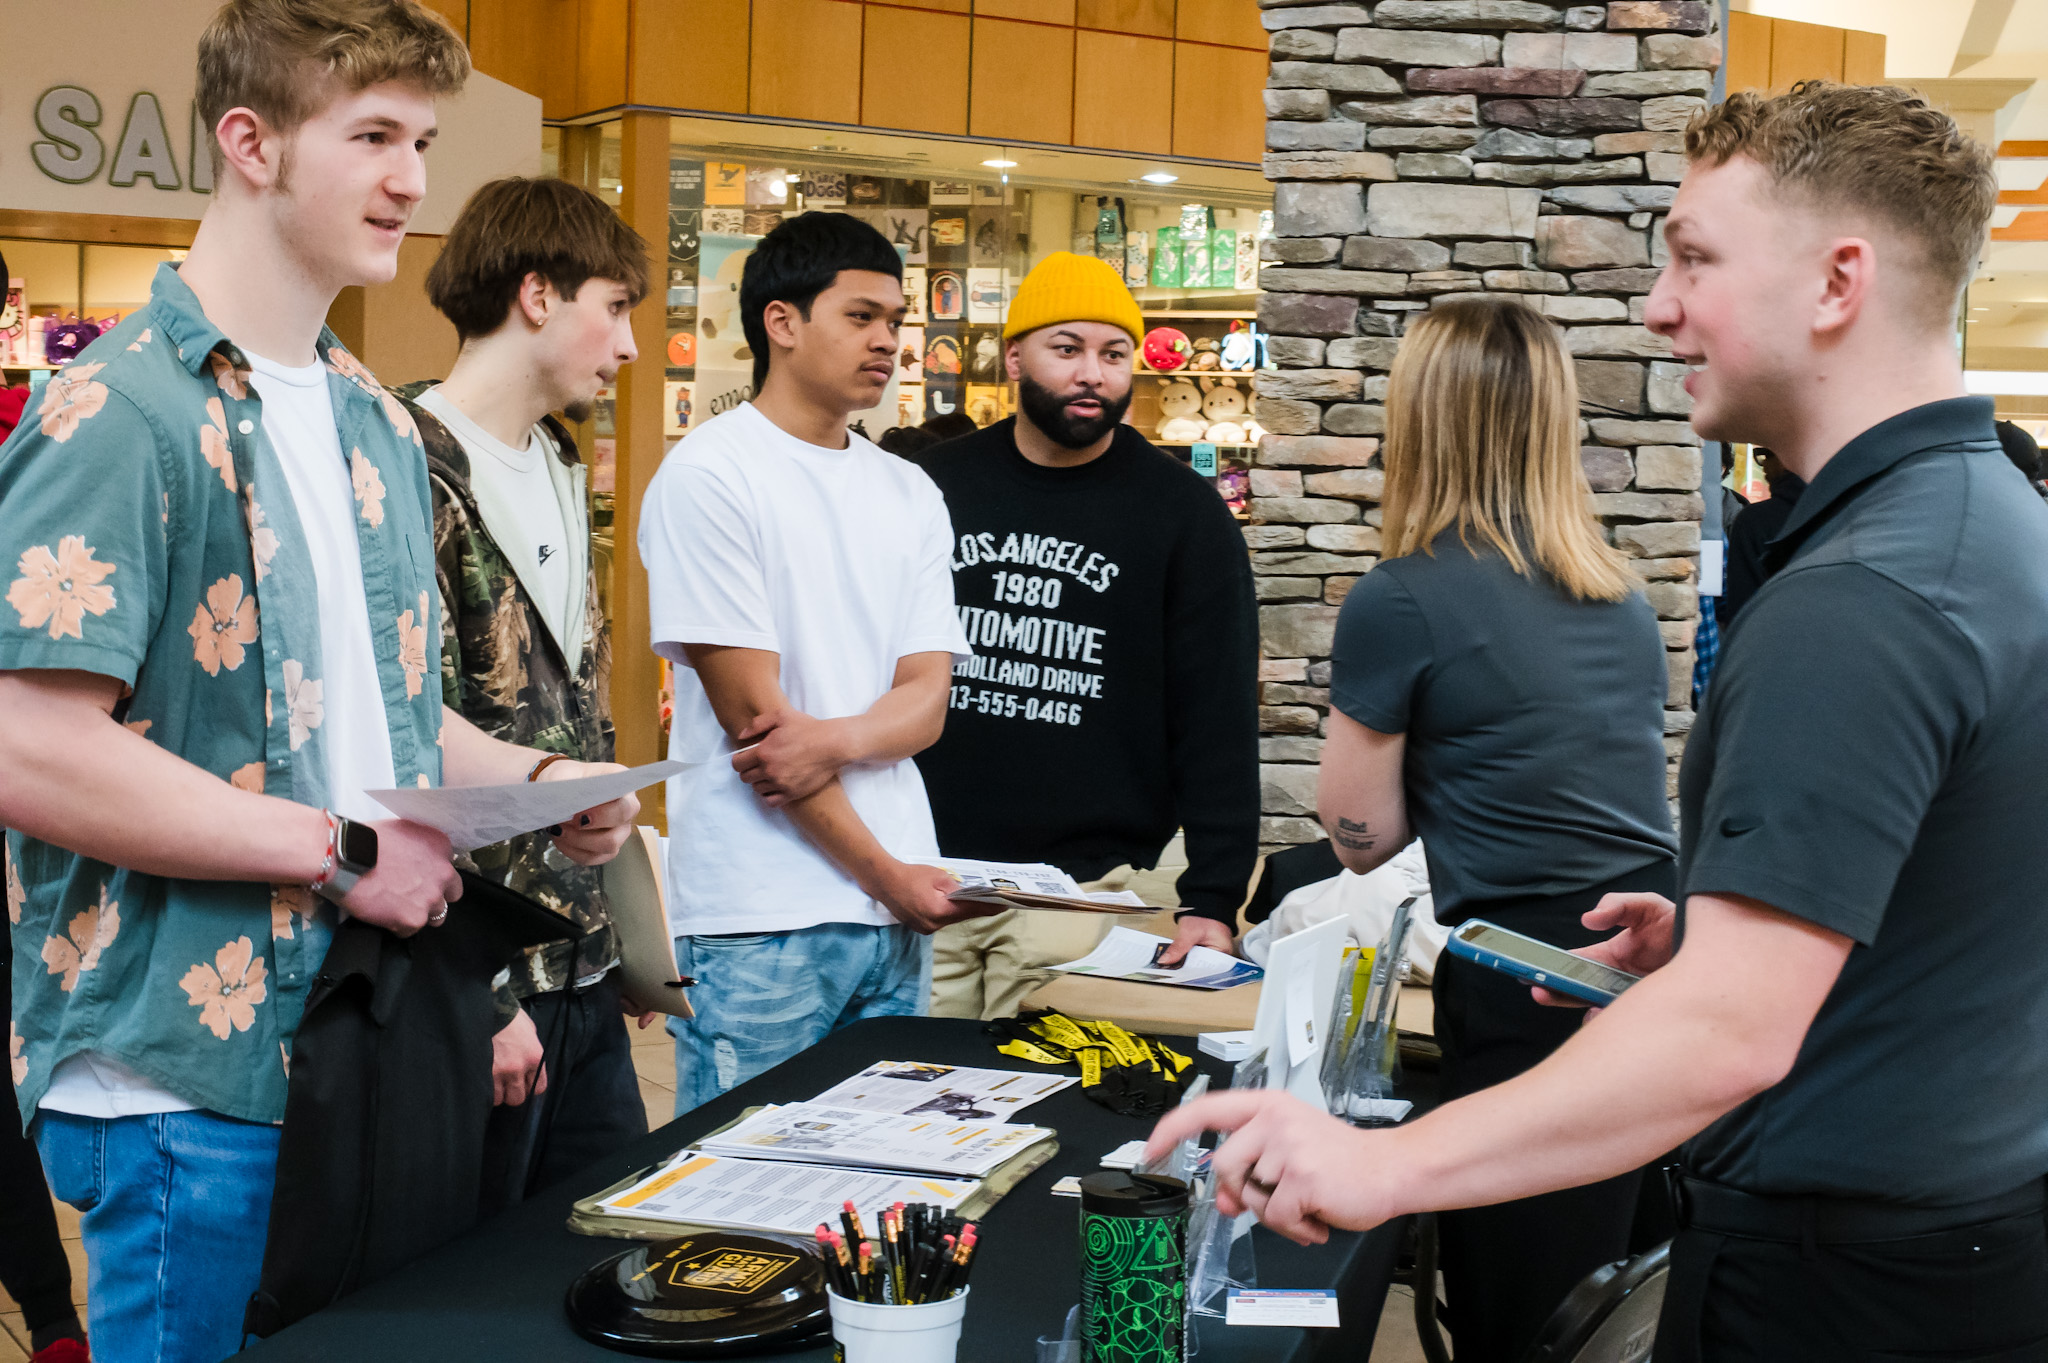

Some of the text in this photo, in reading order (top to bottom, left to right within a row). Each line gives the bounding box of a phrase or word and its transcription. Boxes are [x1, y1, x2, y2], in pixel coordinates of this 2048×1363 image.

[805, 180, 846, 198] DOGS
[998, 532, 1120, 593] ANGELES
[992, 570, 1062, 609] 1980
[955, 604, 1106, 665] TOMOTIVE
[952, 654, 1105, 699] HOLLAND DRIVE
[950, 684, 1083, 726] 13-555-0466
[692, 1253, 743, 1283] GUARD
[722, 1256, 771, 1287] ARMY
